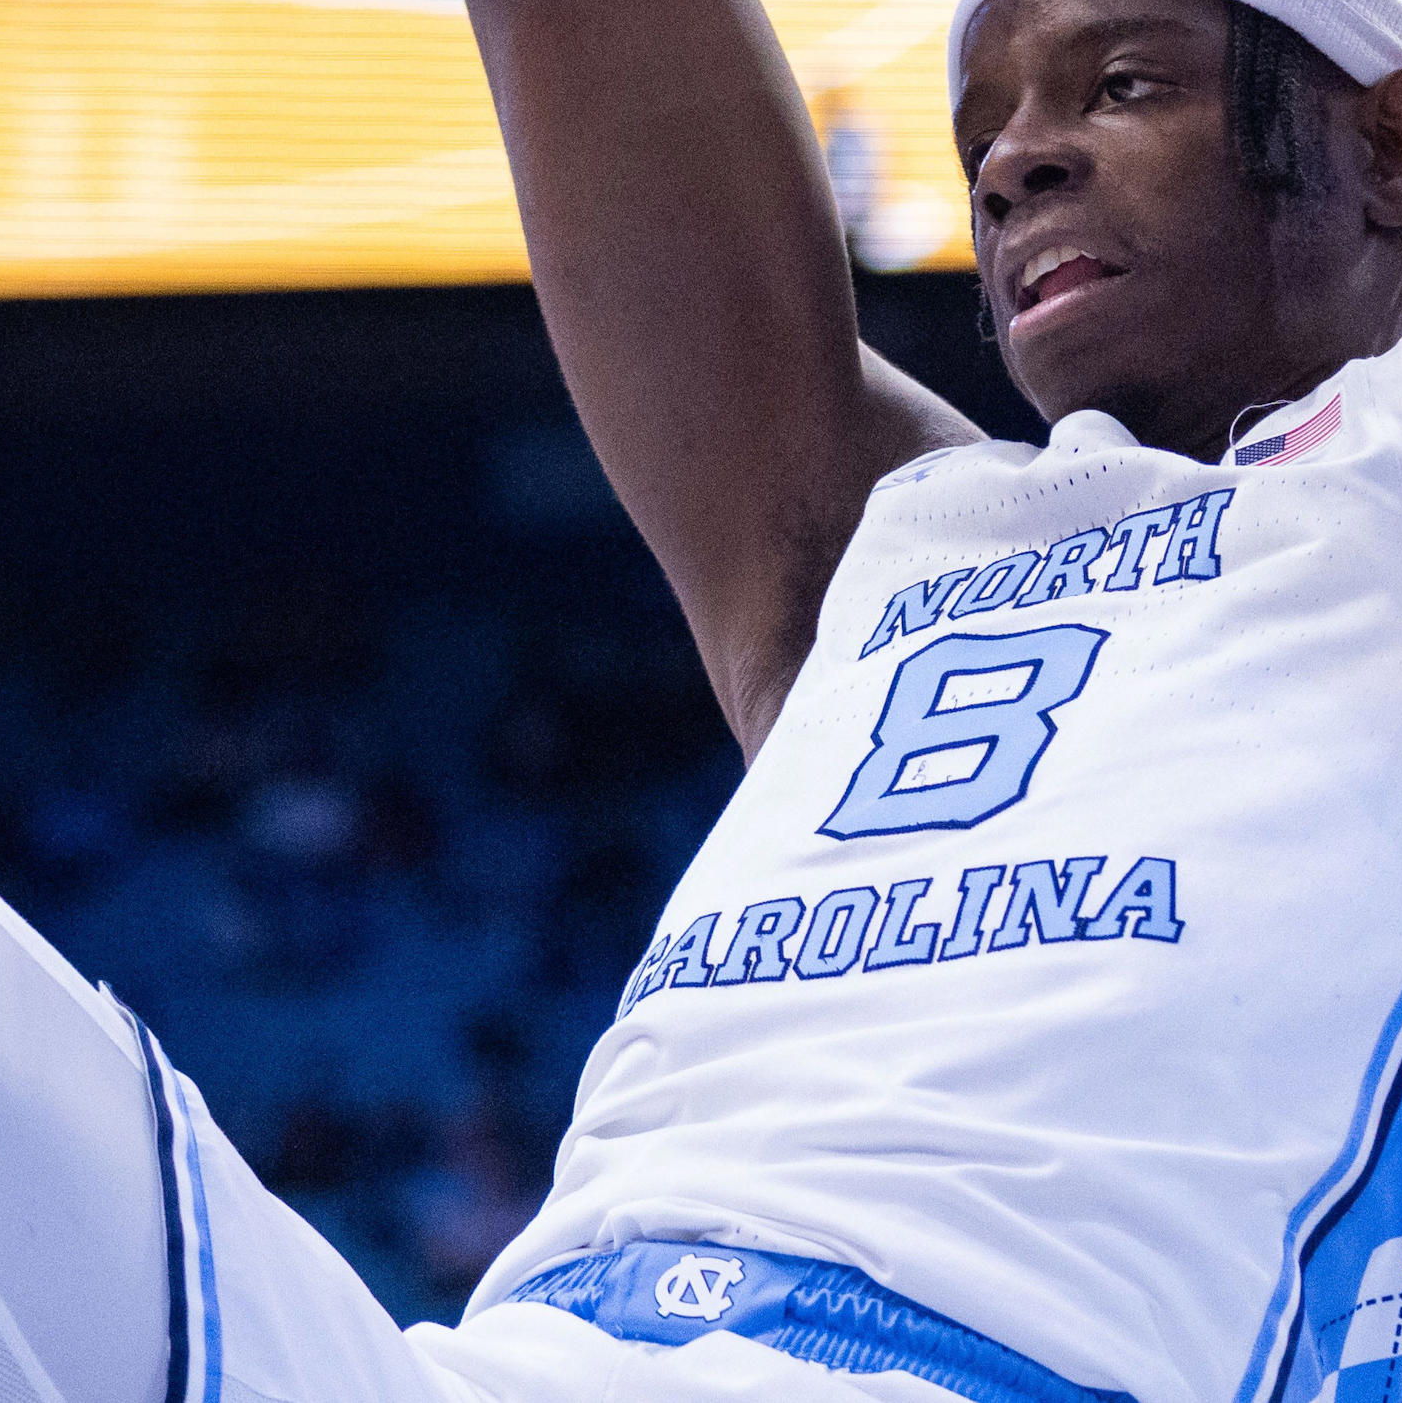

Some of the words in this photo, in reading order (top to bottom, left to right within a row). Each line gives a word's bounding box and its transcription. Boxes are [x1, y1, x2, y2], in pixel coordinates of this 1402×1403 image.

[859, 488, 1235, 659] NORTH
[816, 624, 1110, 840] 8
[617, 856, 1185, 1022] CAROLINA
